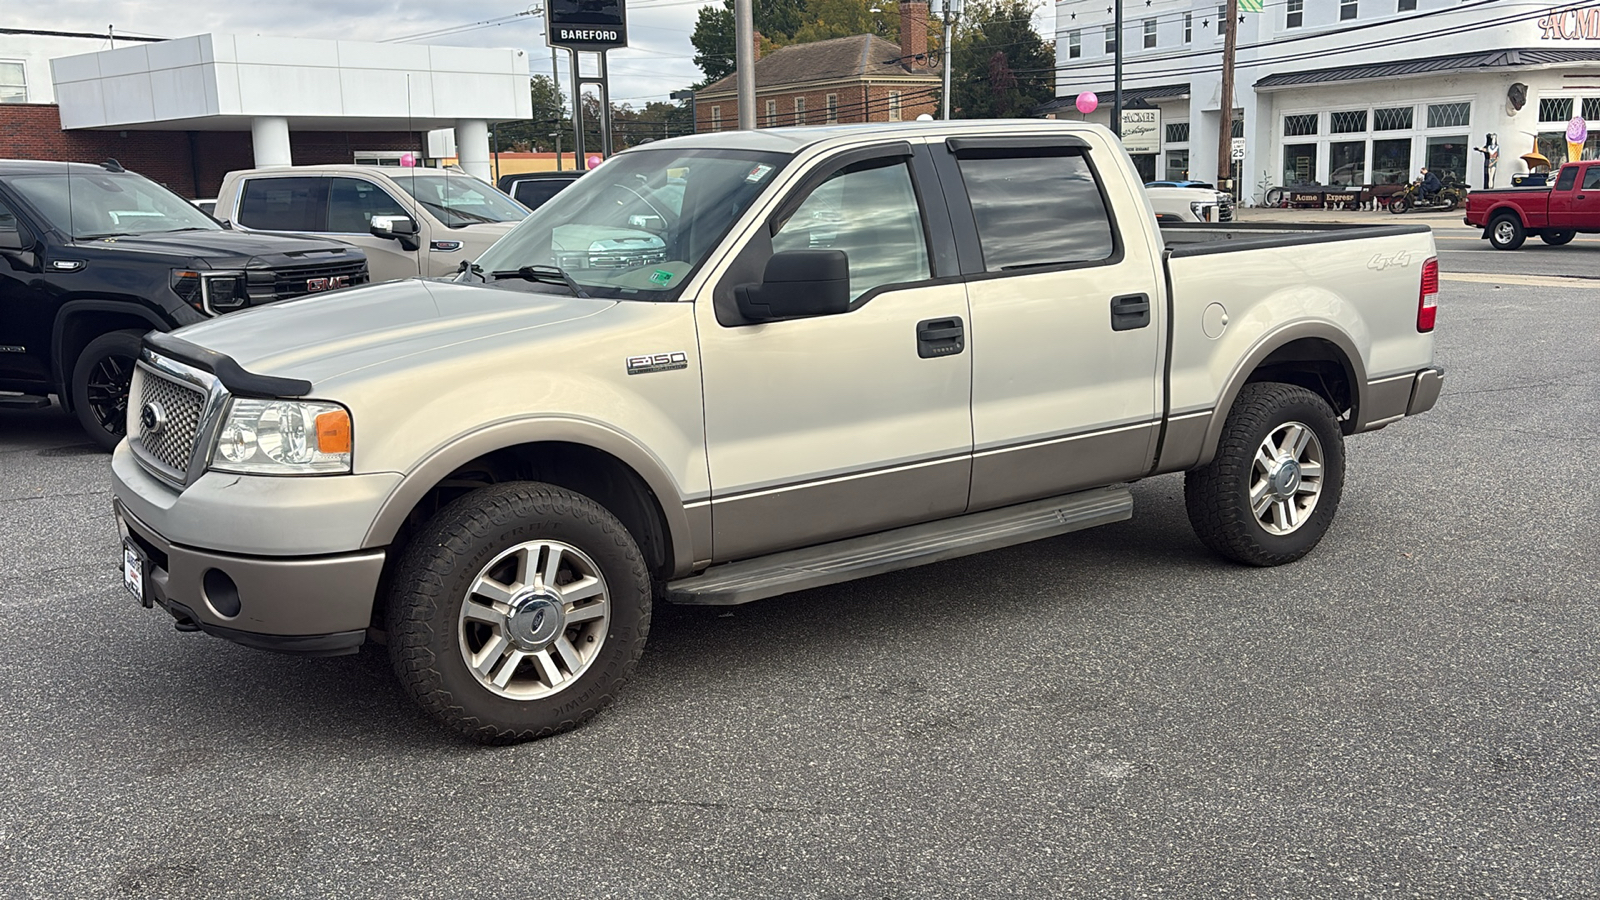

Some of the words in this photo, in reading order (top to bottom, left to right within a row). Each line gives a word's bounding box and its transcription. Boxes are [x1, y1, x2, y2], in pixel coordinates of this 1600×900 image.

[1538, 7, 1600, 40] ACM
[561, 29, 617, 41] BAREFORD
[1122, 112, 1155, 123] ACME
[1233, 149, 1244, 157] 25
[1326, 194, 1354, 202] Express
[1367, 250, 1411, 271] 4x4
[307, 276, 350, 292] GMC
[552, 626, 631, 717] BLACKHAWK
